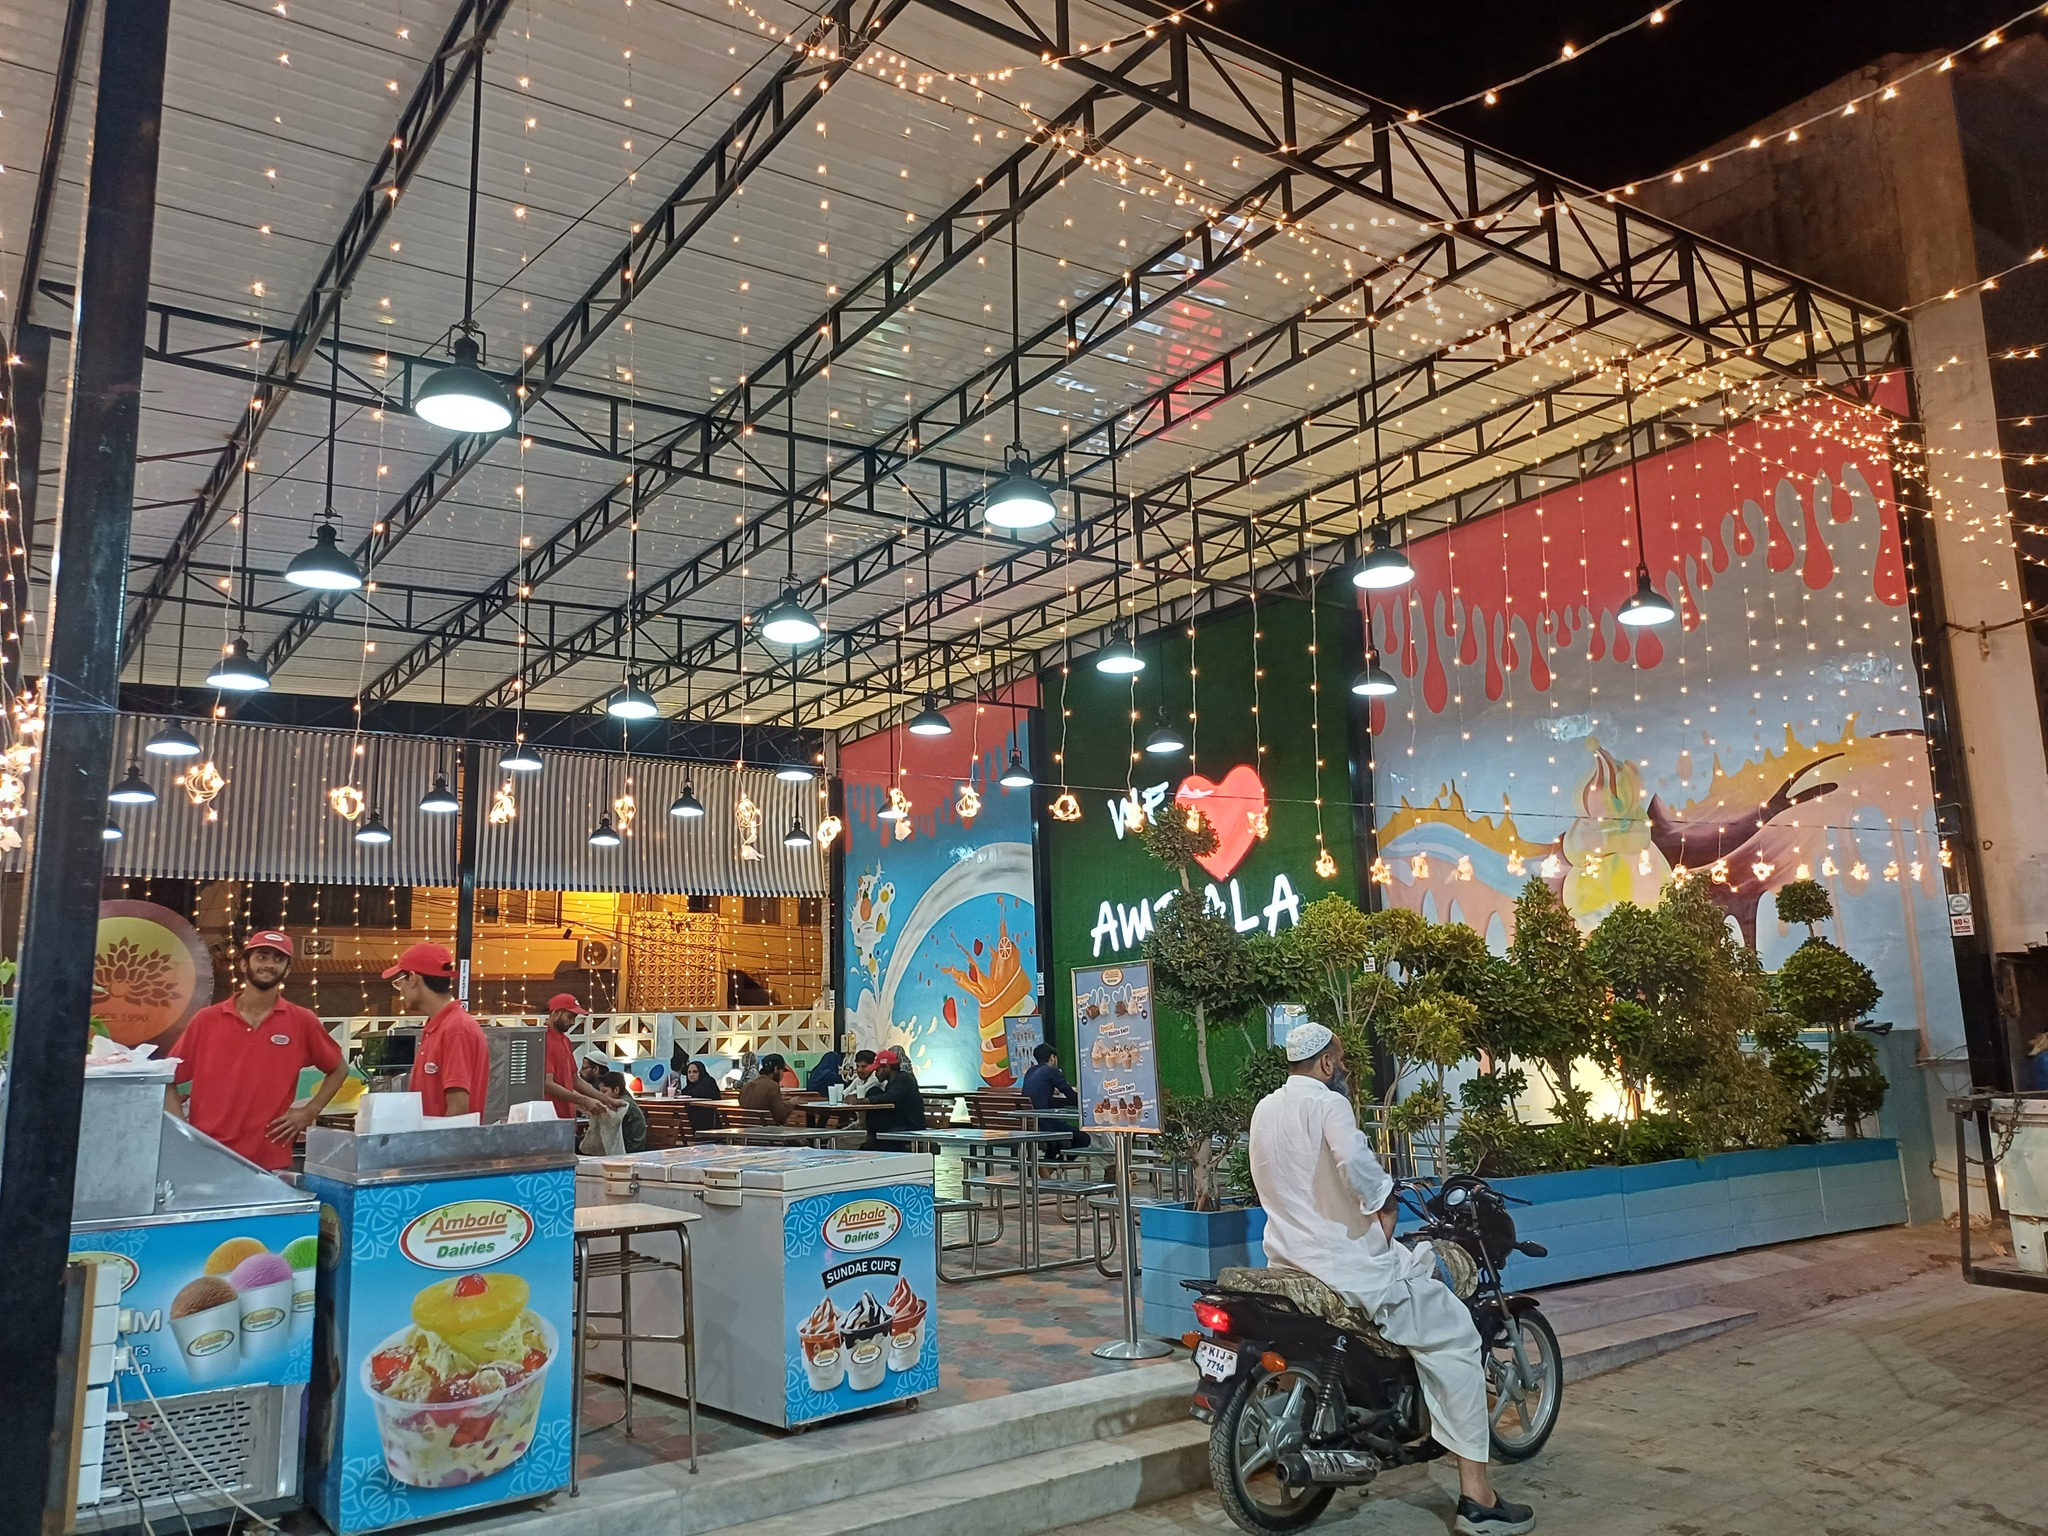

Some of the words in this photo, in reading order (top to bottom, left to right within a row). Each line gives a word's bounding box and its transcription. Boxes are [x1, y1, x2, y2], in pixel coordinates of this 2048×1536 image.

[425, 1210, 508, 1237] Ambala
[837, 1207, 886, 1228] Ambala
[844, 1231, 880, 1244] Dairies
[436, 1241, 496, 1259] Dairies
[826, 1261, 868, 1284] SUNDAE
[870, 1260, 897, 1272] CUPS
[1209, 1347, 1226, 1360] KIJ
[1206, 1359, 1225, 1373] 7714
